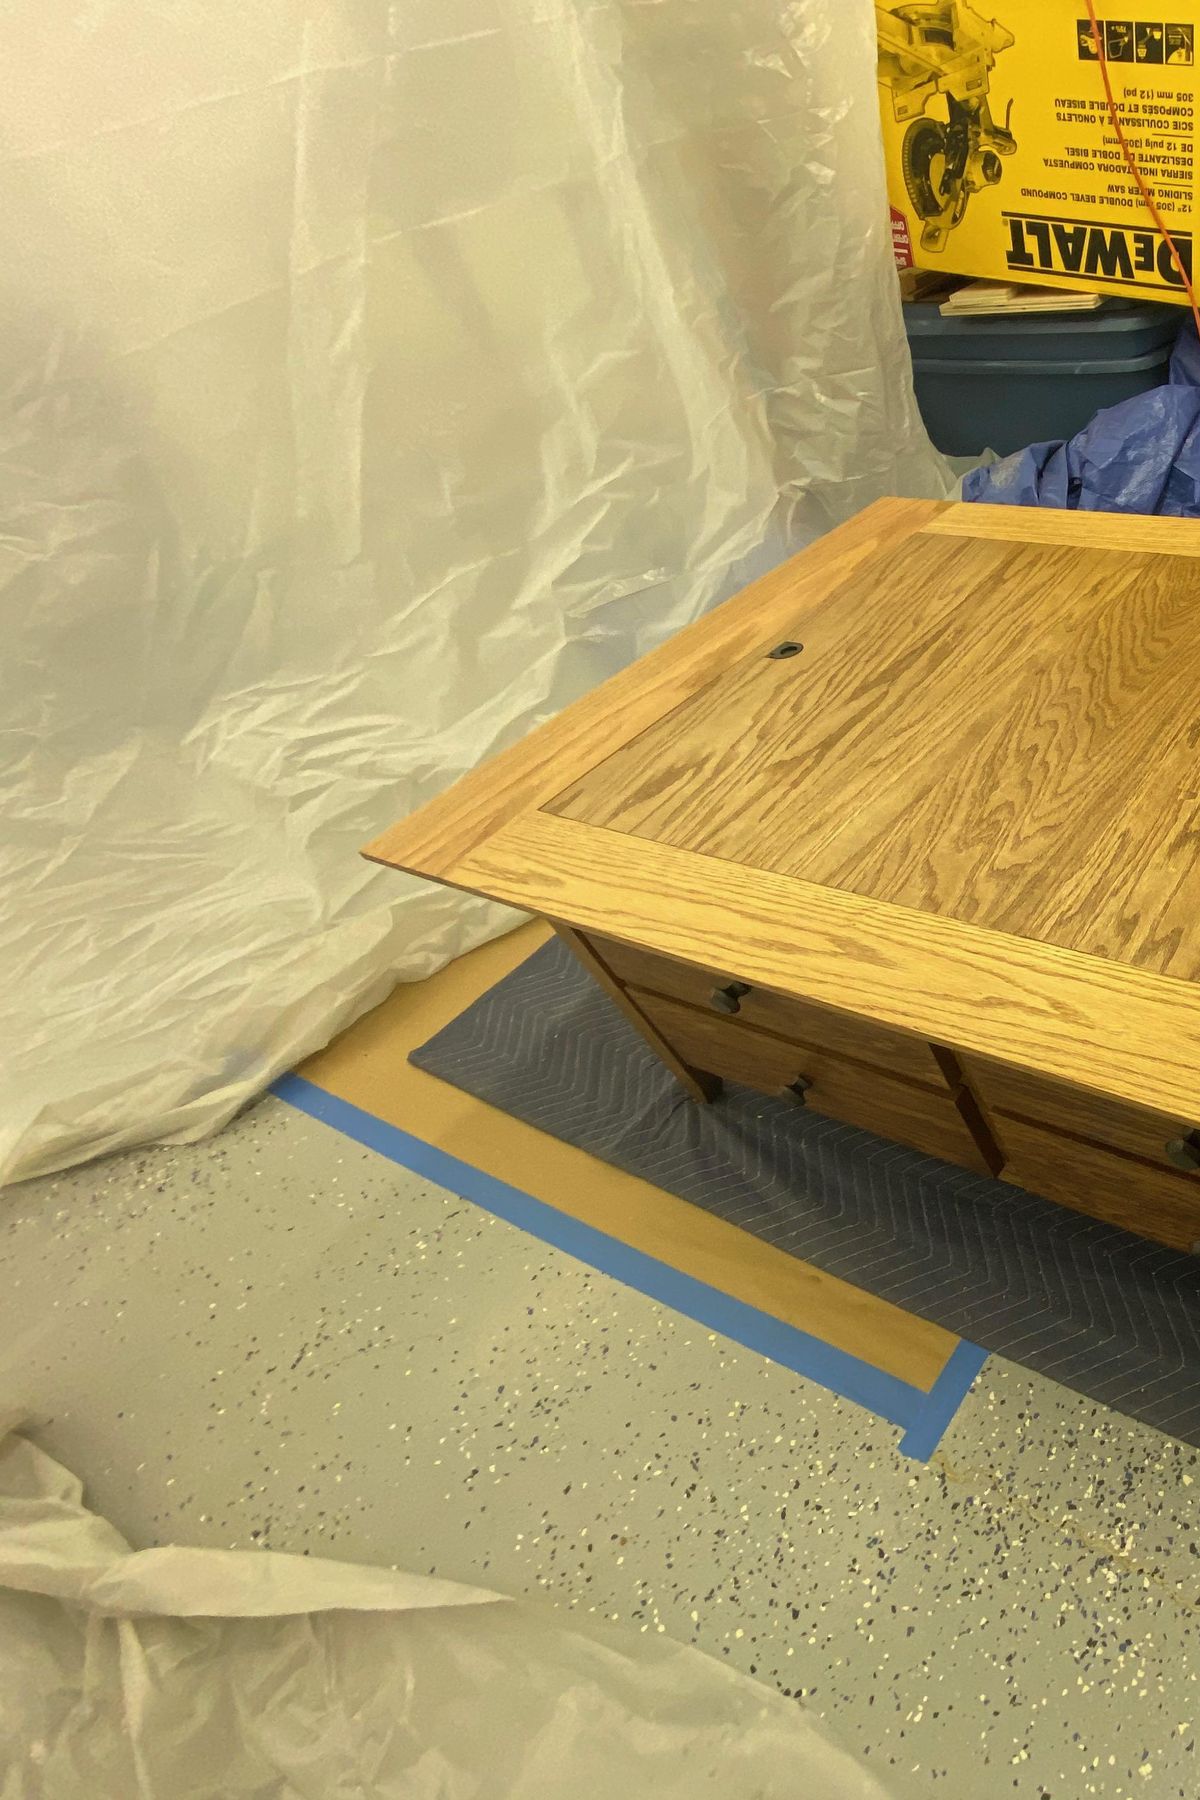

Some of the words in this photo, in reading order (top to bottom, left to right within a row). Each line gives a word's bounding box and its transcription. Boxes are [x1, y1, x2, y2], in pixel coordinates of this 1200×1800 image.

[1123, 87, 1137, 98] po)
[1140, 89, 1154, 100] (12
[1157, 91, 1173, 99] mm
[1176, 92, 1194, 102] 305
[1054, 98, 1086, 109] BISEAU
[1128, 103, 1139, 113] ET
[1056, 112, 1096, 124] ONGLETS
[1107, 116, 1169, 129] COULISSANE
[1172, 121, 1193, 131] SCIE
[1145, 138, 1164, 149] pulg
[1166, 142, 1177, 151] 12
[1181, 143, 1193, 152] DE
[1064, 146, 1089, 157] BISEL
[1092, 149, 1120, 160] DOBLE
[1042, 158, 1094, 171] COMPUESTA
[1138, 153, 1193, 166] DESLIZANTE
[1097, 163, 1158, 177] INGLTADORA
[1161, 169, 1193, 180] SIERRA
[1020, 188, 1067, 200] COMPOUND
[1107, 184, 1125, 194] SAW
[1158, 189, 1193, 200] SLIDING
[1070, 192, 1096, 203] BEVEL
[1099, 196, 1133, 207] DOUBLE
[1156, 201, 1175, 212] (305
[1005, 219, 1193, 286] DEWALT
